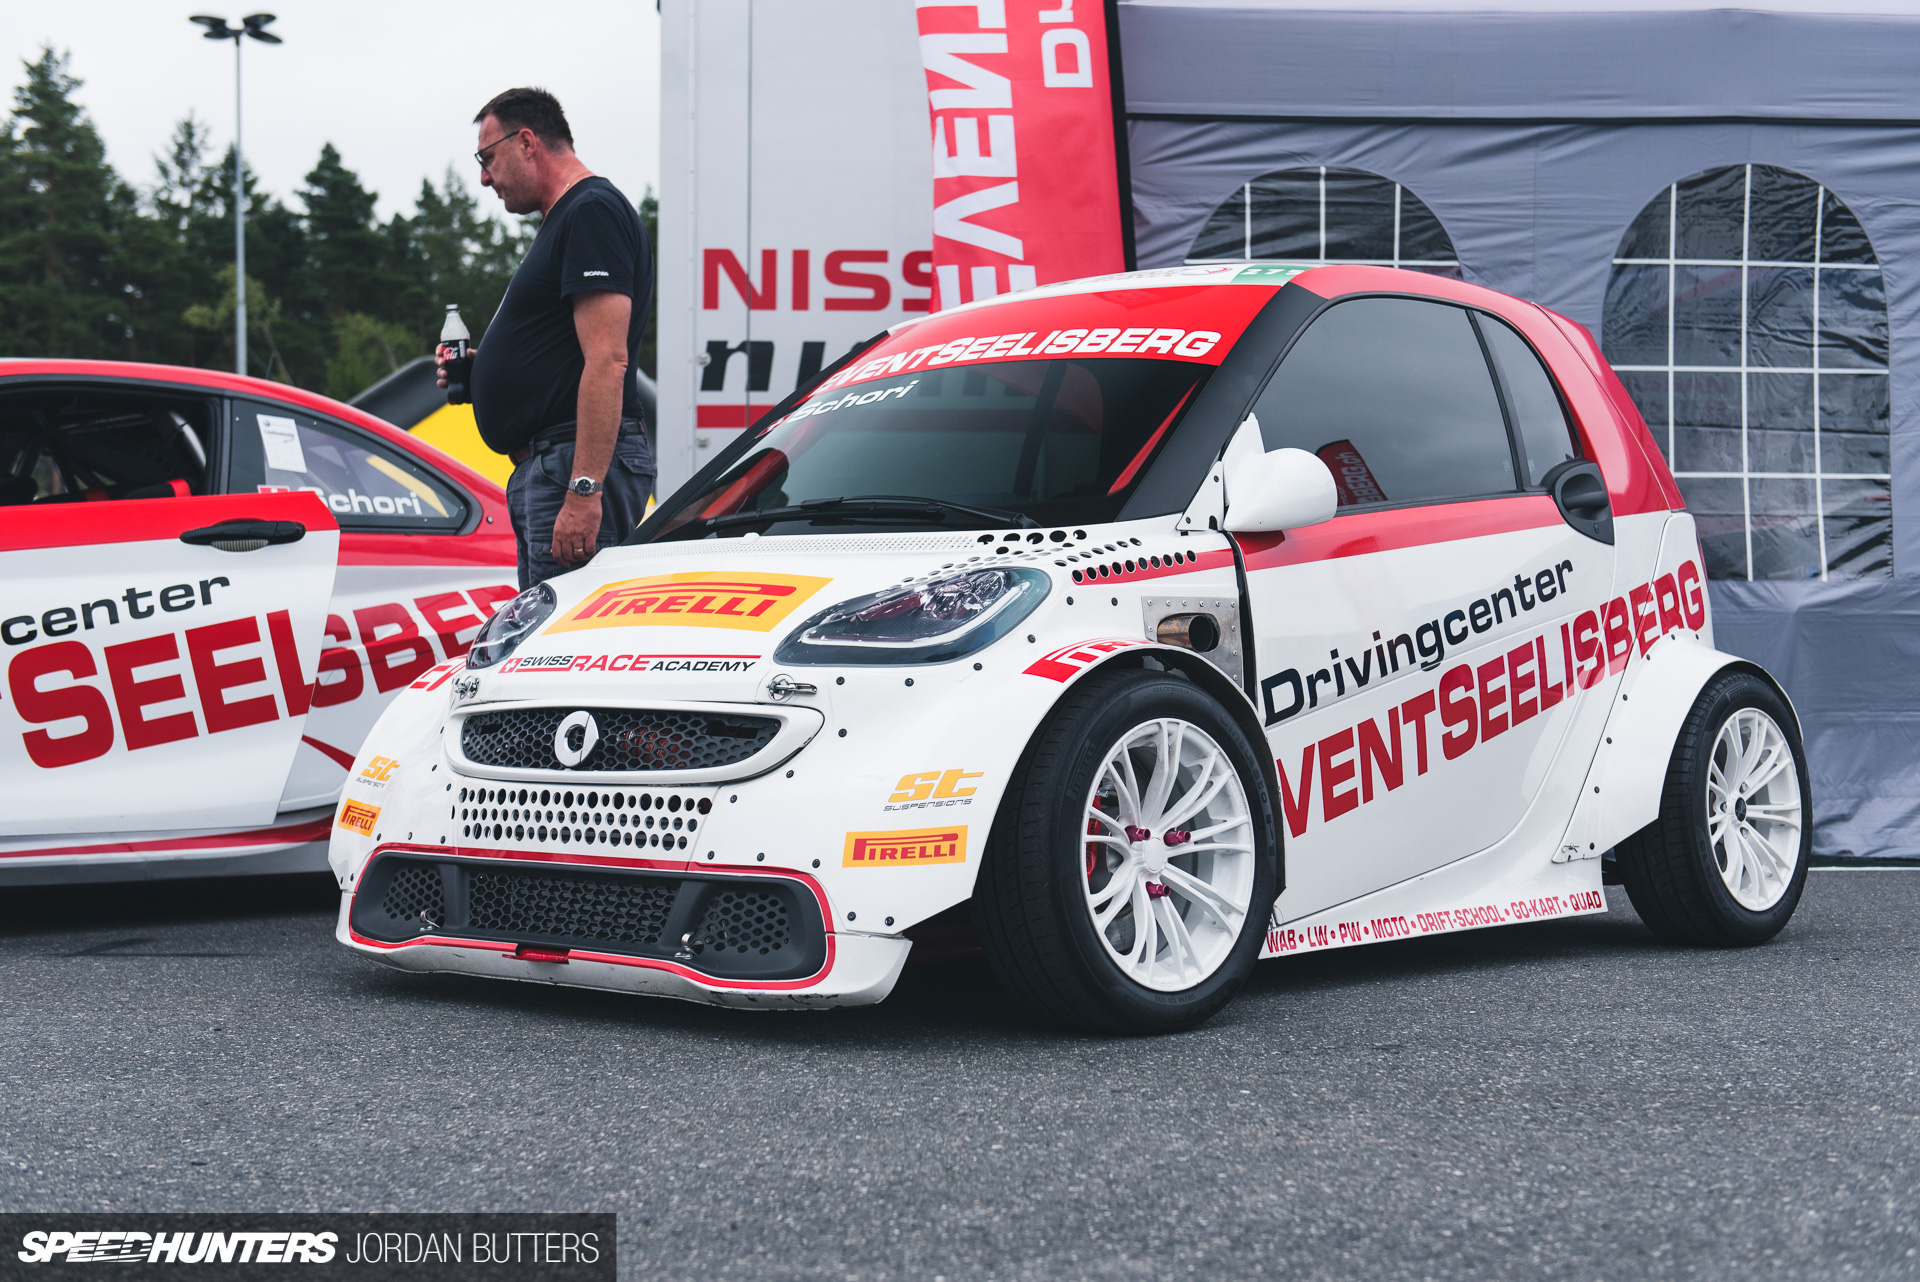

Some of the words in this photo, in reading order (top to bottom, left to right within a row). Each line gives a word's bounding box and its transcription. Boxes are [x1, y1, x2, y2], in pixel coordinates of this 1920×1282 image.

[1, 576, 230, 645] center
[571, 581, 797, 621] PIRELLI
[520, 655, 573, 667] SWISS
[569, 654, 652, 672] RACE
[651, 660, 757, 672] ACADEMY
[1260, 559, 1573, 727] Drivingcenter
[341, 804, 377, 831] PIRELLI
[852, 832, 959, 861] PIRELLI
[1266, 928, 1297, 953] WAB
[1307, 925, 1329, 948] LW
[1338, 921, 1362, 944] PW
[1371, 915, 1410, 939] MOTO
[1569, 890, 1602, 912] QUAD
